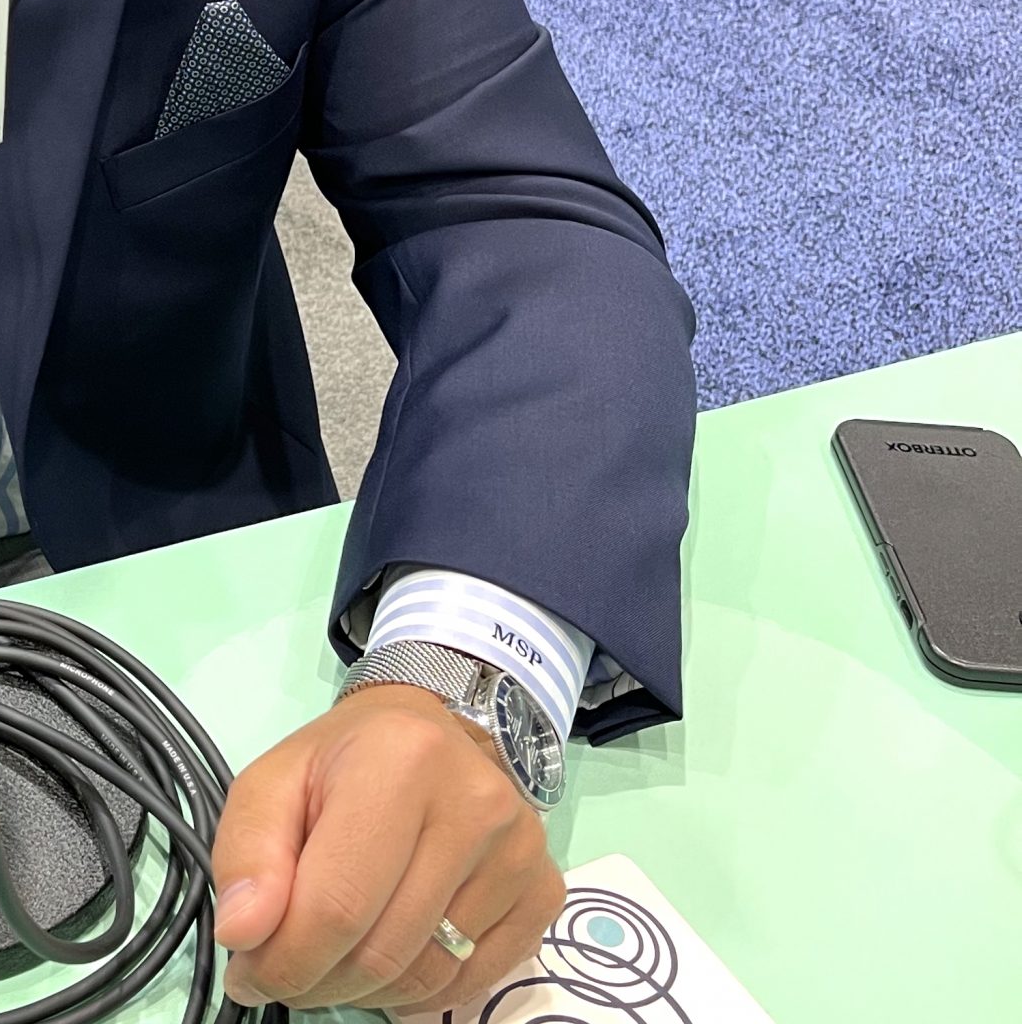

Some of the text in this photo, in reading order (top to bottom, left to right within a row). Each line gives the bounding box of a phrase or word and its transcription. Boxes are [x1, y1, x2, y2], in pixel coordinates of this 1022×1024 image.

[884, 441, 977, 457] OTTERBOX
[492, 622, 543, 666] MSP
[59, 662, 115, 696] MICROPHONE
[162, 740, 181, 764] MADE
[177, 762, 187, 773] IN
